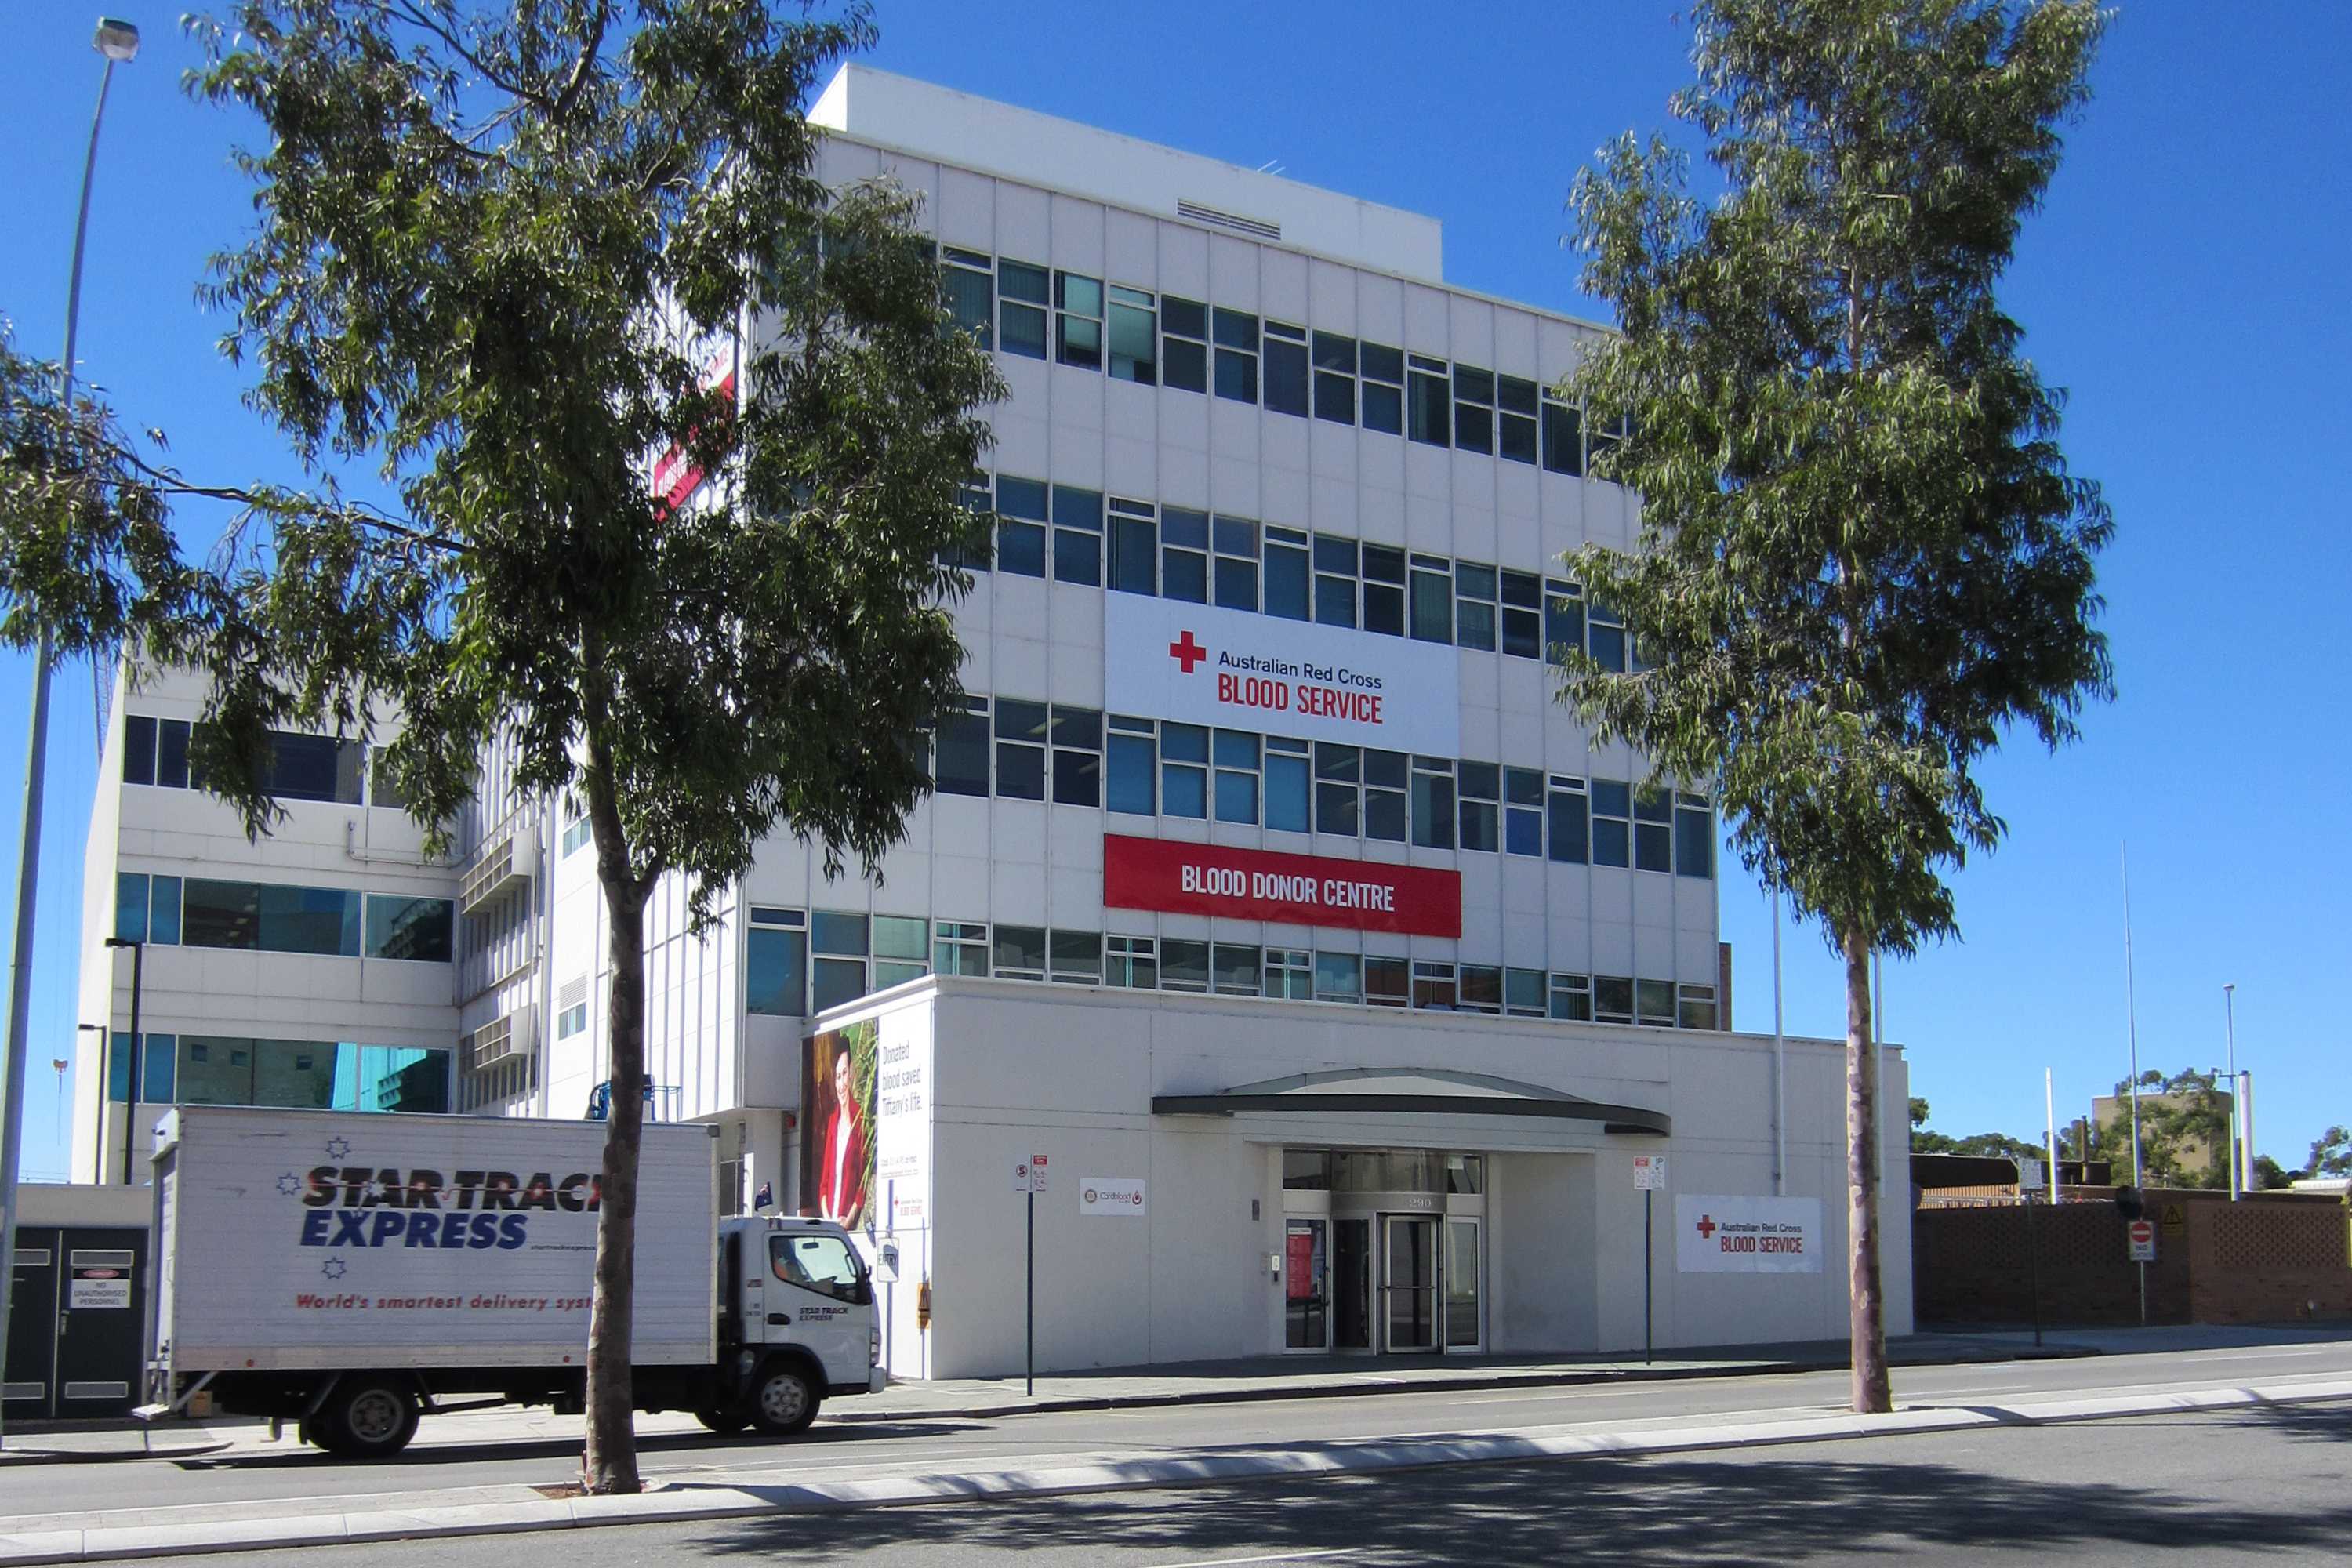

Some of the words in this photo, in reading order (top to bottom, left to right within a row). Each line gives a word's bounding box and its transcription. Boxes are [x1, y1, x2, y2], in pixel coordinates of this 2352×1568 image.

[1218, 651, 1298, 677] Australian
[1303, 663, 1333, 681] Red
[1338, 668, 1382, 689] Cross
[1218, 673, 1289, 710] BLOOD
[1296, 684, 1383, 724] SERVICE
[1181, 865, 1247, 898] BLOOD
[1252, 872, 1318, 904] DONOR
[1323, 879, 1395, 912] CENTRE
[883, 1039, 910, 1065] Donated
[882, 1069, 901, 1091] blood
[902, 1063, 921, 1087] saved
[303, 1166, 444, 1209] STAR
[1410, 1198, 1432, 1208] 290
[300, 1210, 528, 1250] EXPRESS
[1721, 1222, 1760, 1232] Australian
[1762, 1223, 1777, 1232] Red
[1779, 1224, 1802, 1233] Cross
[1721, 1236, 1756, 1253] BLOOD
[1759, 1236, 1802, 1254] SERVICE
[297, 1294, 368, 1309] World's
[376, 1294, 462, 1309] smartest
[470, 1294, 547, 1312] delivery
[555, 1298, 591, 1312] syst
